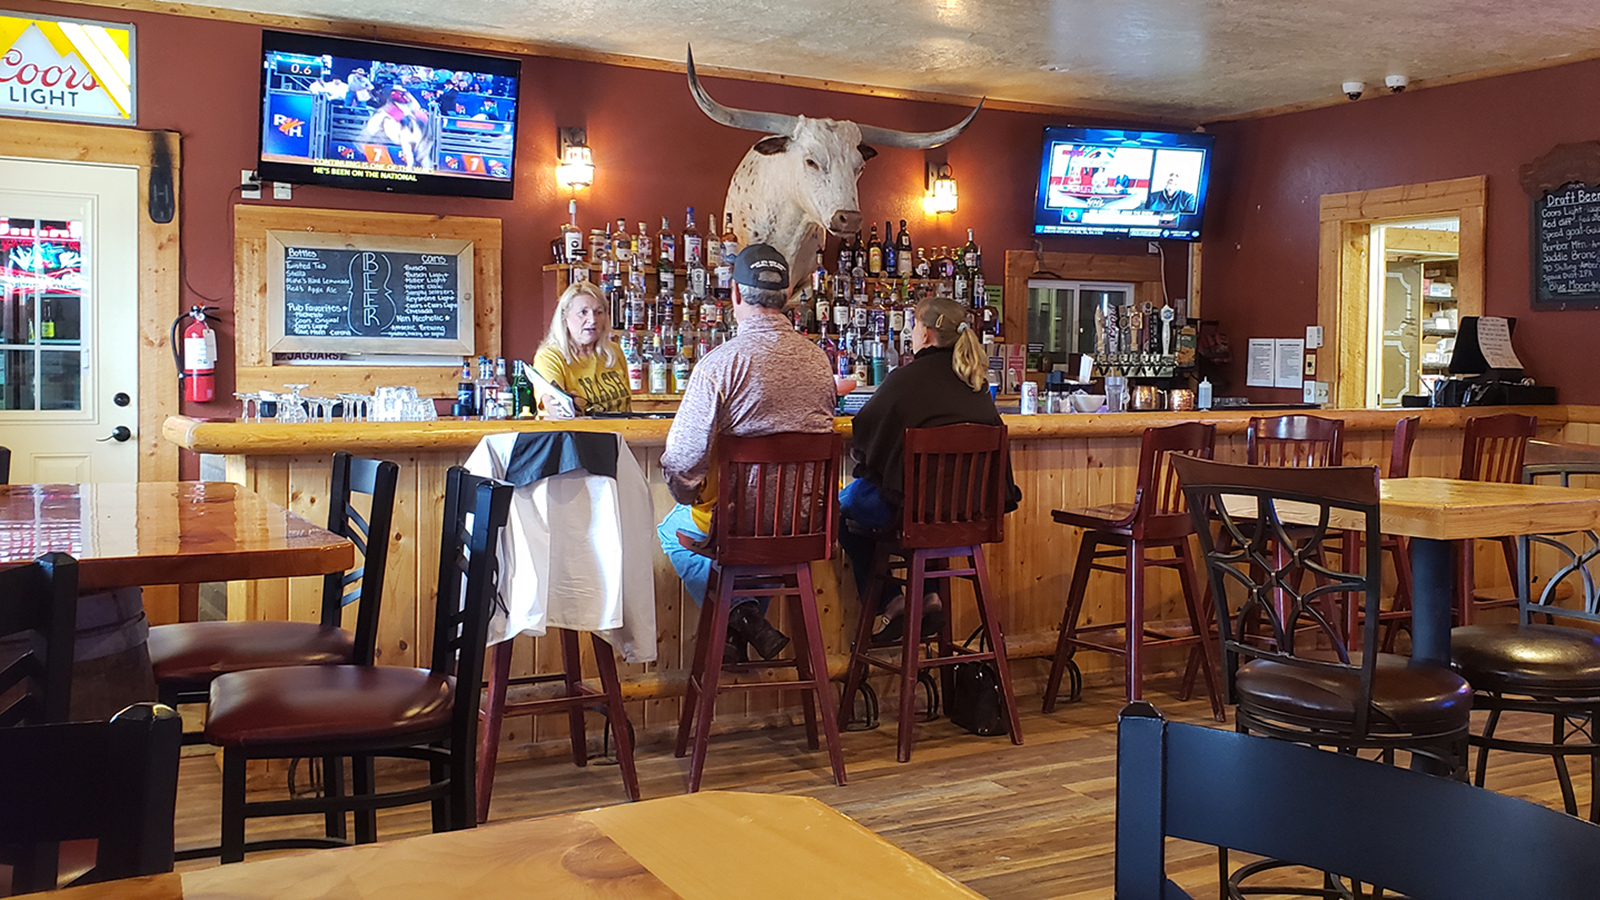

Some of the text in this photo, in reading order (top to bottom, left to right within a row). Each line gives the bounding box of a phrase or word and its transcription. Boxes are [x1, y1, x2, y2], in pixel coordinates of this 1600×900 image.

[0, 48, 100, 91] Coors
[290, 63, 312, 75] 0.6
[9, 86, 79, 107] LIGHT
[313, 166, 418, 181] HE'S BEEN ON THE NATIONAL
[1547, 191, 1575, 205] Draft
[1541, 209, 1562, 217] Coors
[1564, 205, 1582, 219] Light
[1543, 219, 1556, 228] Red
[1542, 228, 1564, 241] Speed
[288, 248, 318, 257] Bottles
[1542, 241, 1569, 252] Bomber
[1543, 252, 1568, 262] Saddle
[1572, 250, 1596, 260] Bronc
[312, 261, 327, 270] Tea
[1549, 282, 1567, 290] Blue
[287, 303, 342, 313] Pub Favorites
[287, 352, 339, 360] JAGUARS
[578, 370, 629, 403] NASH
